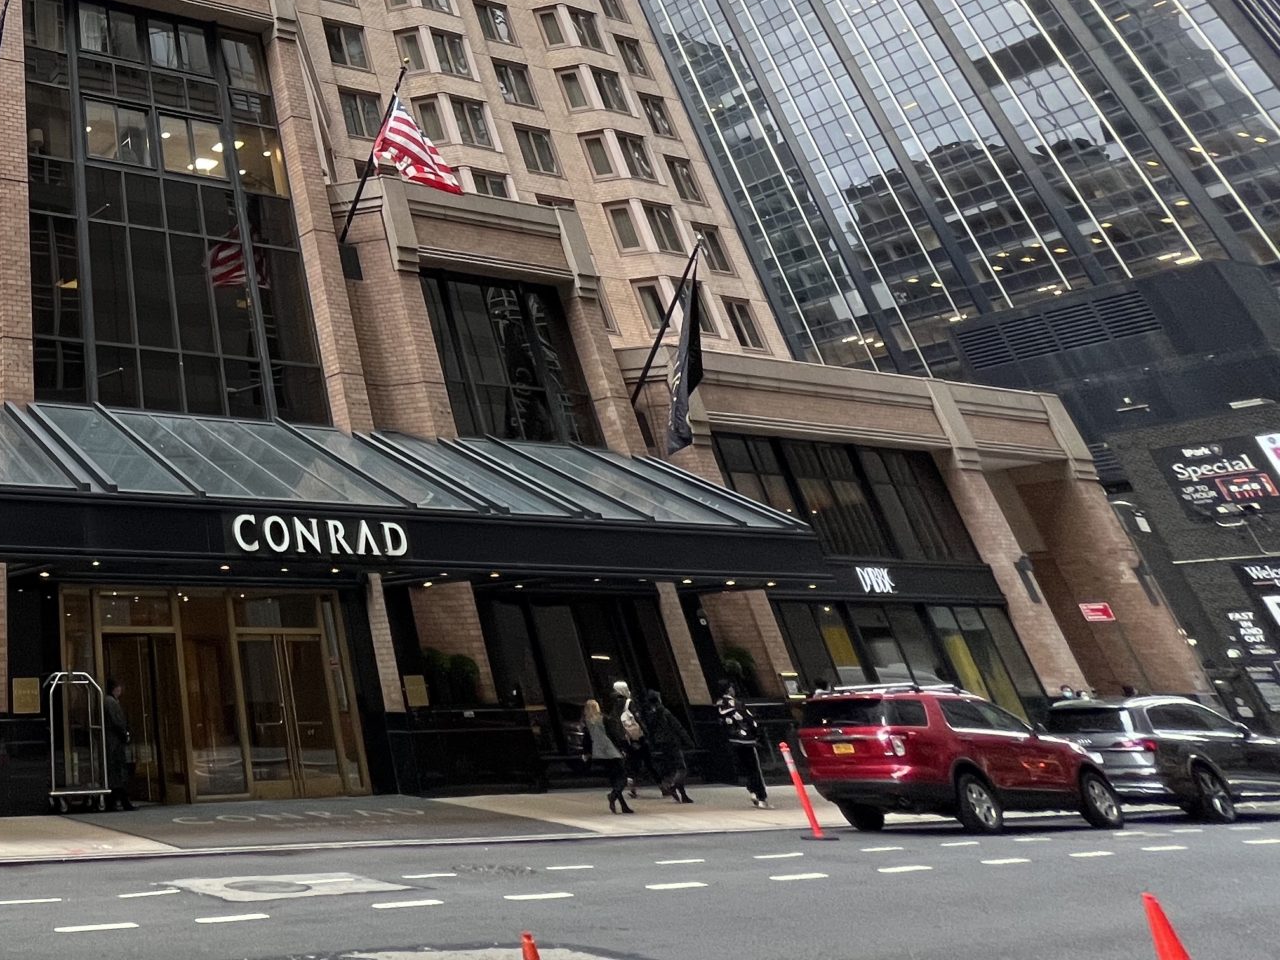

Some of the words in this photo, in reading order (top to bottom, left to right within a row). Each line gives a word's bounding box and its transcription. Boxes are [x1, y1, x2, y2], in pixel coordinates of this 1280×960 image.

[1172, 453, 1256, 482] Special
[232, 513, 408, 557] CONRAD
[1227, 612, 1254, 620] FAST
[1240, 627, 1263, 635] AND
[1244, 634, 1265, 642] OUT
